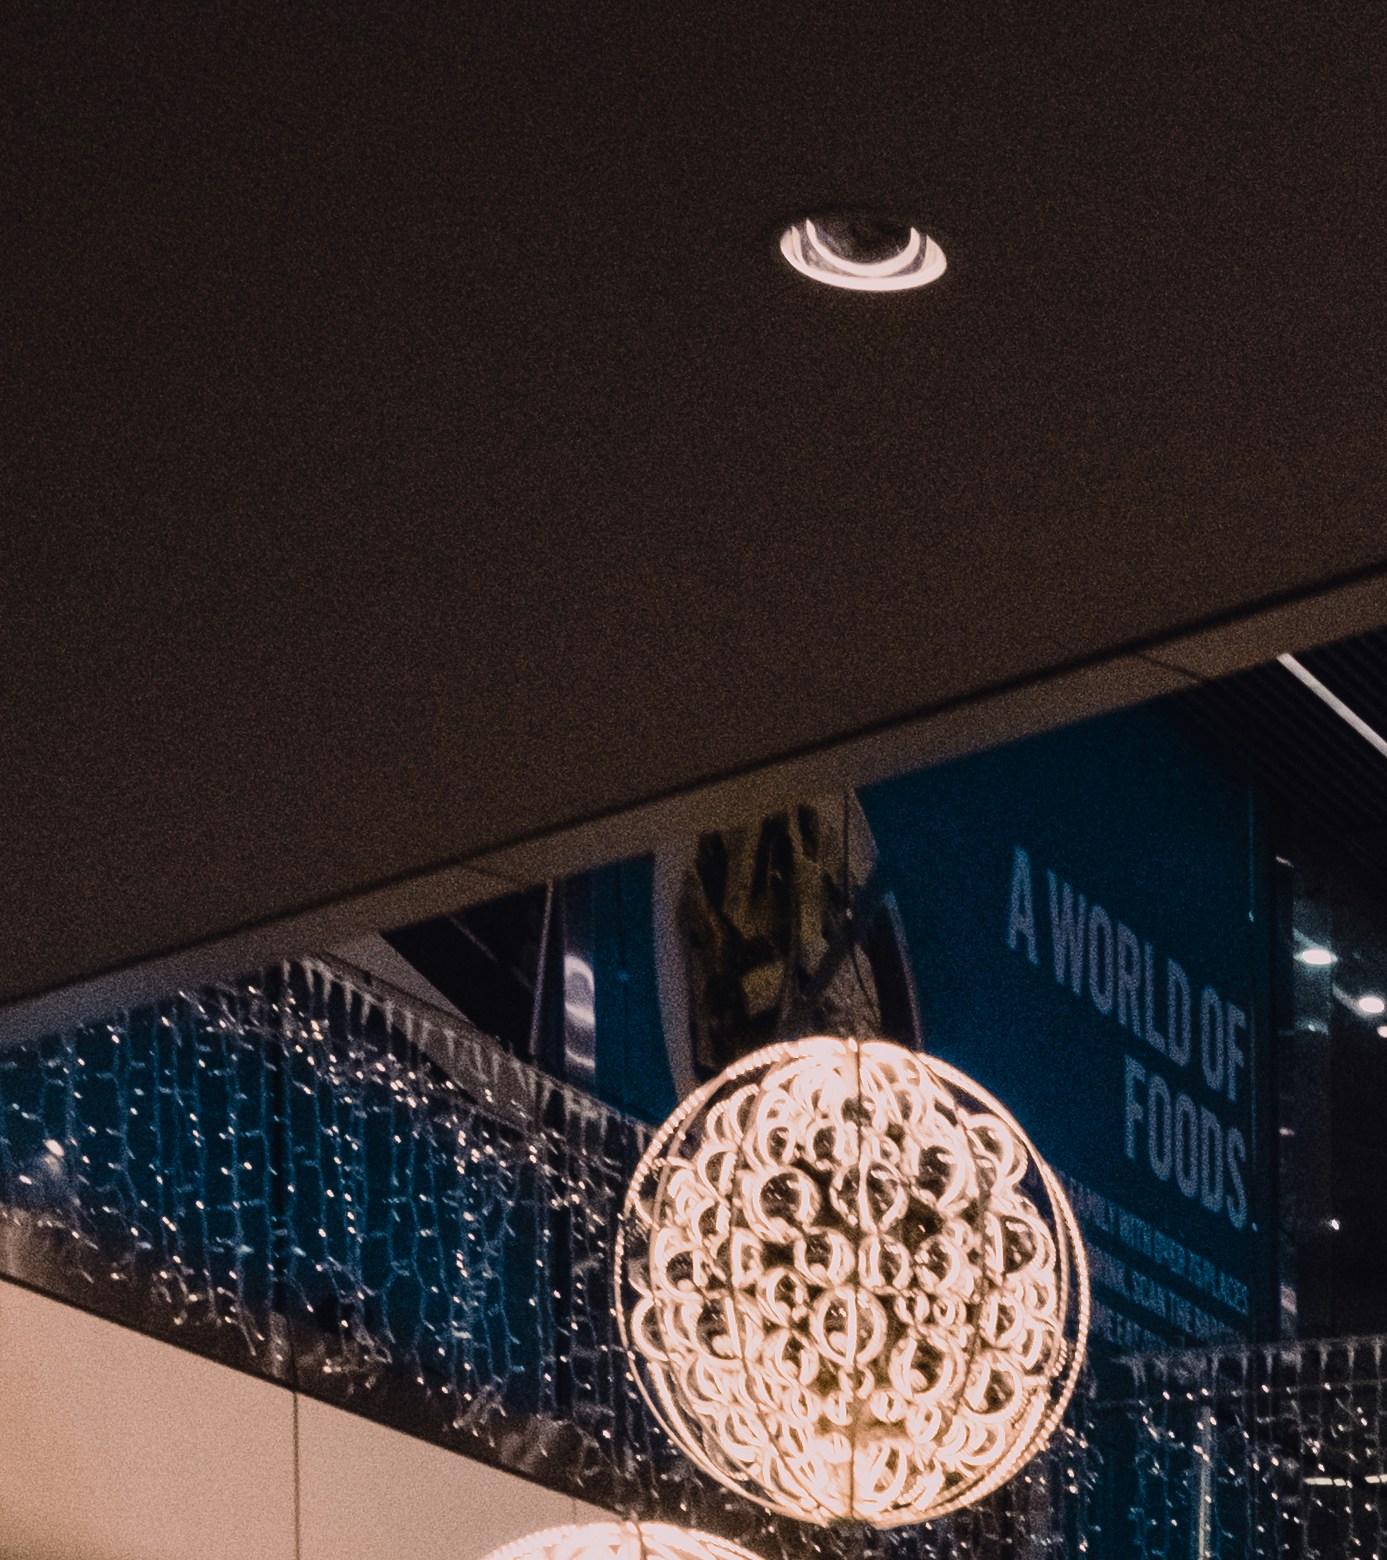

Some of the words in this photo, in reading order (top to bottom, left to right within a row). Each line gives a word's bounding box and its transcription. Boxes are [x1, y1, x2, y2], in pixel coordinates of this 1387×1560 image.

[1007, 844, 1038, 967] A
[1046, 868, 1192, 1068] WORLD
[1200, 984, 1247, 1102] OF
[1123, 1053, 1248, 1231] FOODS
